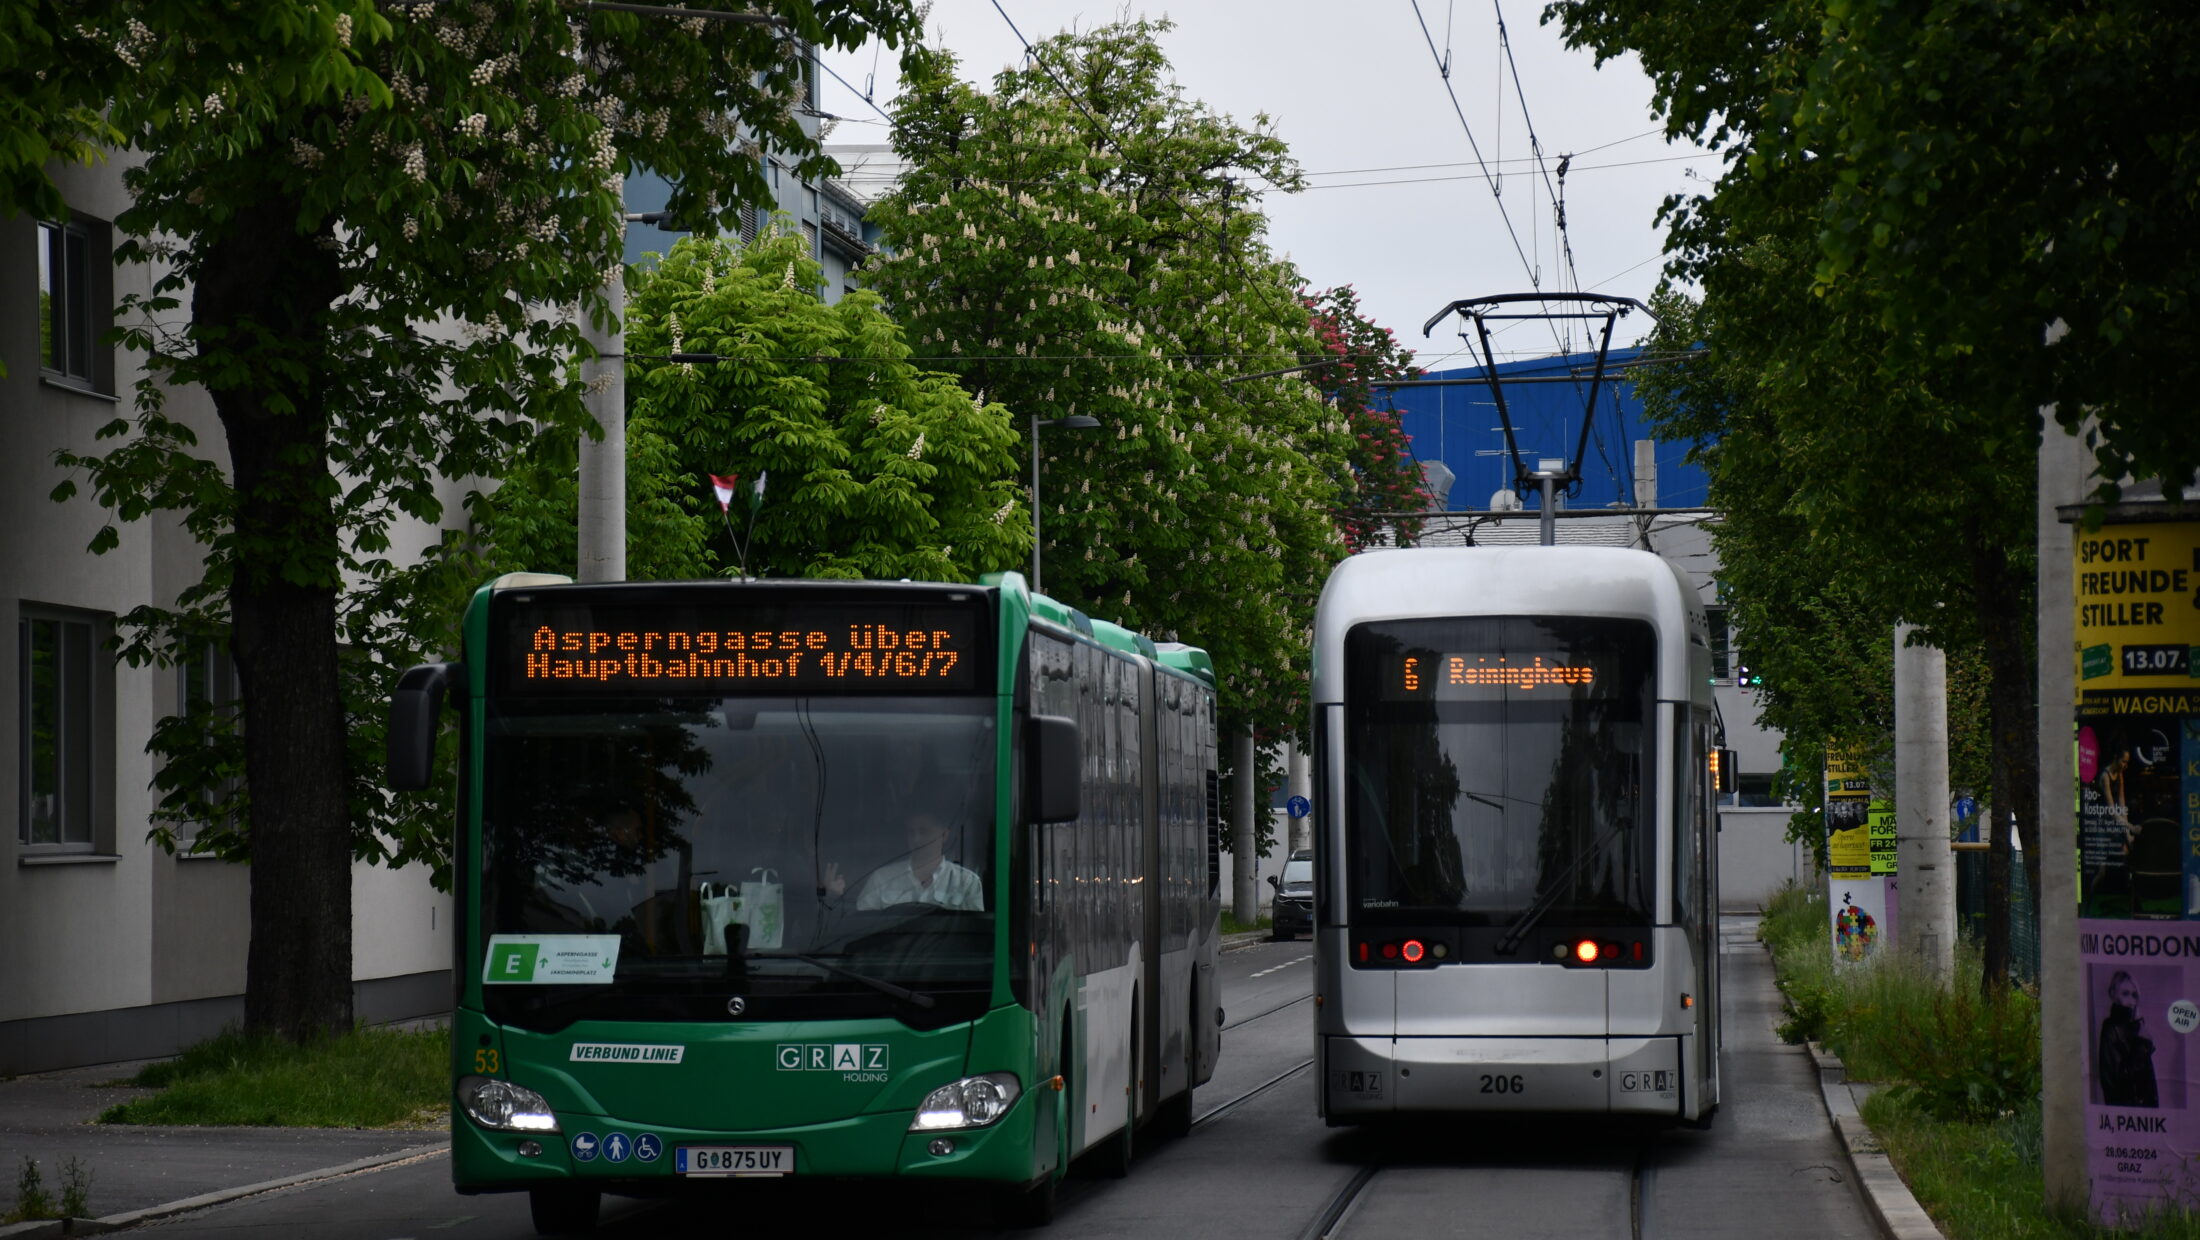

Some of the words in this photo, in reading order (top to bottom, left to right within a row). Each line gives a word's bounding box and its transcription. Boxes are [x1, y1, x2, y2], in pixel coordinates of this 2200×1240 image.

[2082, 538, 2150, 563] SPORT
[2082, 569, 2188, 595] FREUNDE
[2082, 602, 2164, 627] STILLER
[534, 626, 827, 653] Asperngasse
[850, 624, 951, 649] über
[527, 652, 803, 681] Hauptbahnhof
[820, 651, 958, 676] 1/4/6/7
[2126, 650, 2187, 669] 13.07.
[1450, 656, 1594, 689] Reininghaus
[2112, 696, 2191, 714] WAGNA
[2084, 802, 2129, 818] Kostprobe
[2080, 933, 2099, 955] KIM
[2102, 934, 2200, 957] GORDON
[505, 954, 522, 974] E
[2172, 1006, 2197, 1020] OPEN
[2174, 1017, 2190, 1028] AIR
[474, 1049, 499, 1073] 53
[576, 1046, 639, 1060] VERBUND
[642, 1047, 679, 1061] LINIE
[778, 1045, 887, 1070] GRAZ
[843, 1072, 888, 1083] HOLDING
[1480, 1074, 1524, 1094] 206
[1621, 1072, 1676, 1092] GRAZ
[2100, 1114, 2115, 1133] JA,
[2117, 1115, 2167, 1133] PANIK
[697, 1151, 708, 1169] G
[2117, 1162, 2142, 1174] GRAZ
